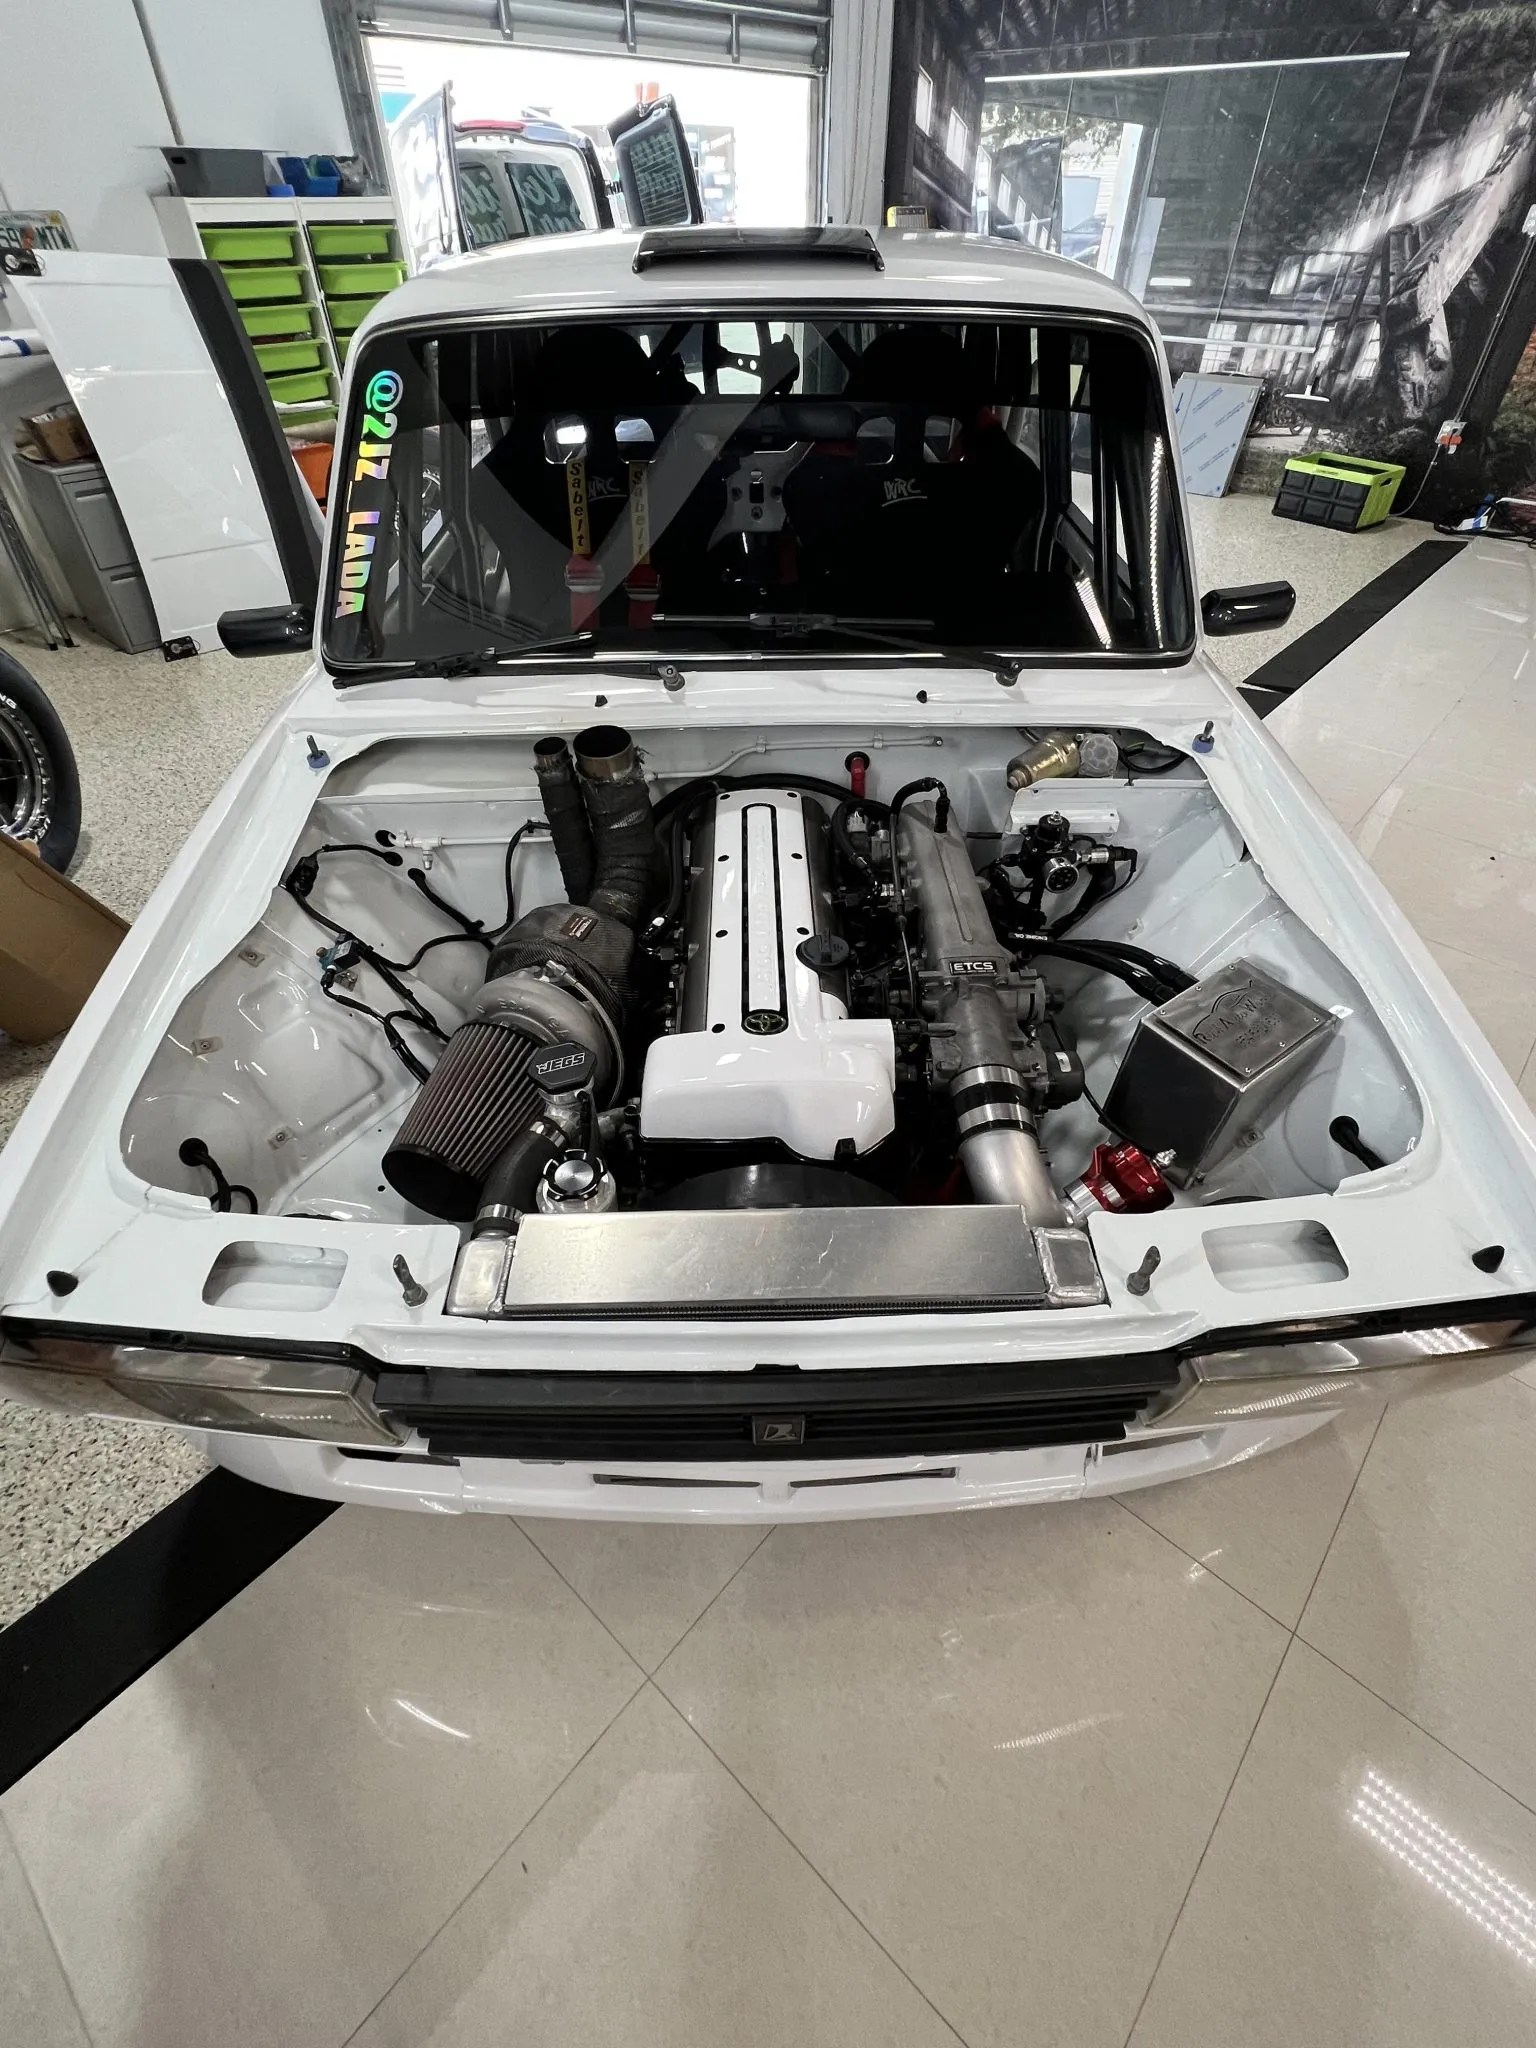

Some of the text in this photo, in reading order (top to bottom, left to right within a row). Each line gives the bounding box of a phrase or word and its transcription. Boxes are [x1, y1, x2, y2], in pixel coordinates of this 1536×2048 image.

[334, 370, 404, 619] @2JZ_LADA
[883, 477, 922, 501] WRC
[569, 462, 585, 547] Sabelt
[953, 961, 995, 971] ETCS
[536, 1052, 586, 1075] JEGS
